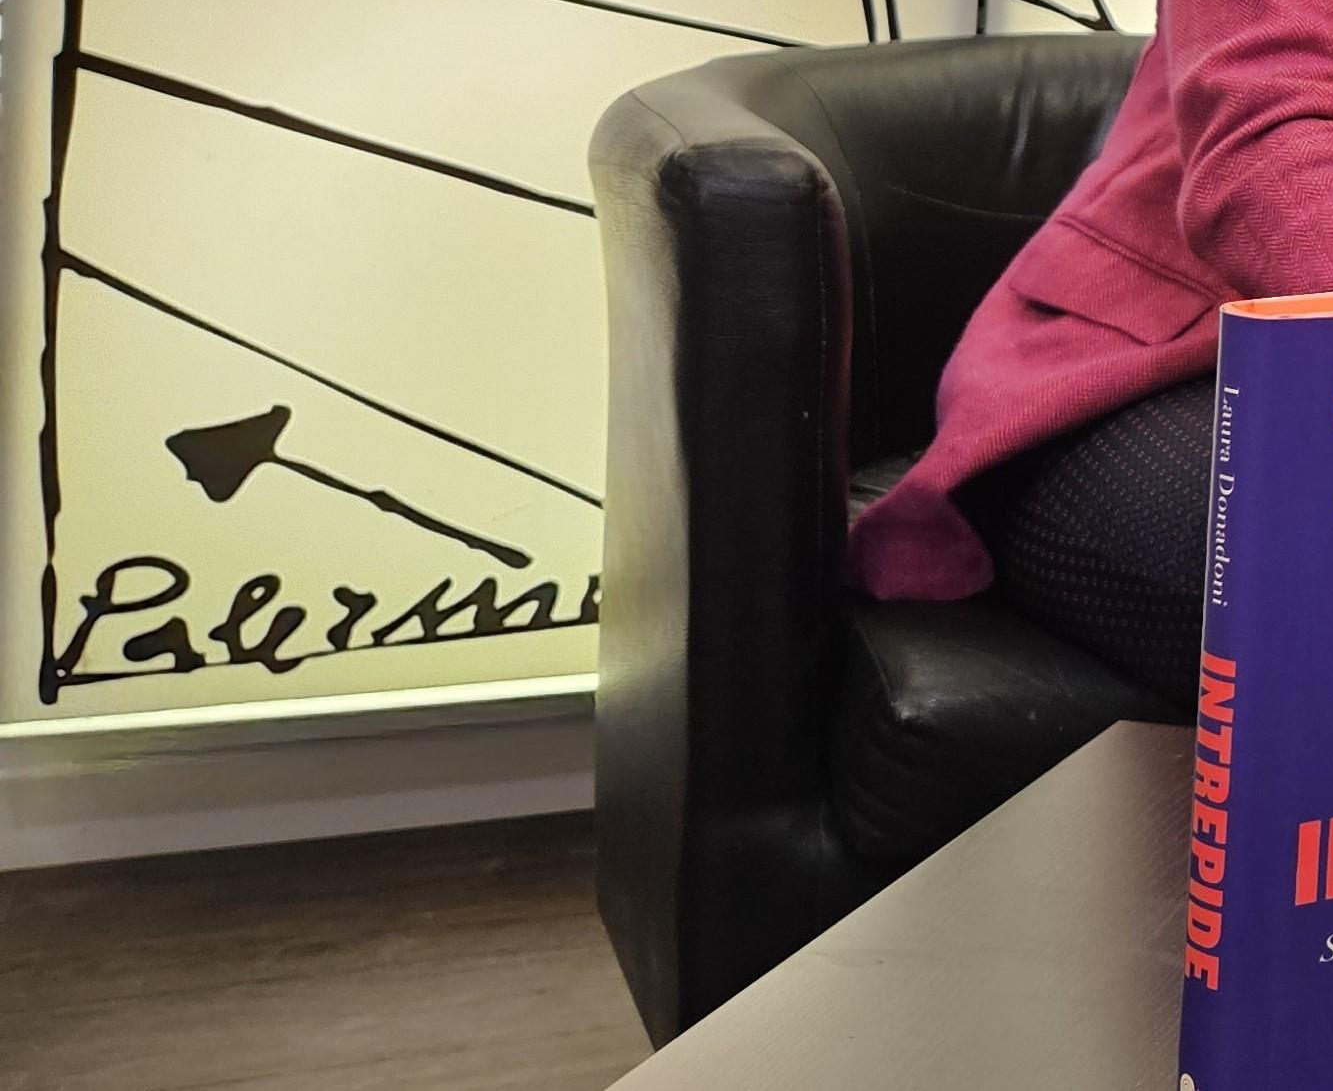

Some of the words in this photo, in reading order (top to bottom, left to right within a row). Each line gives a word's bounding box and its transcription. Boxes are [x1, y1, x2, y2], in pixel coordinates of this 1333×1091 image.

[1217, 383, 1241, 463] Laura
[1211, 472, 1237, 608] Donadoni
[1184, 651, 1238, 991] INTREPIDE
